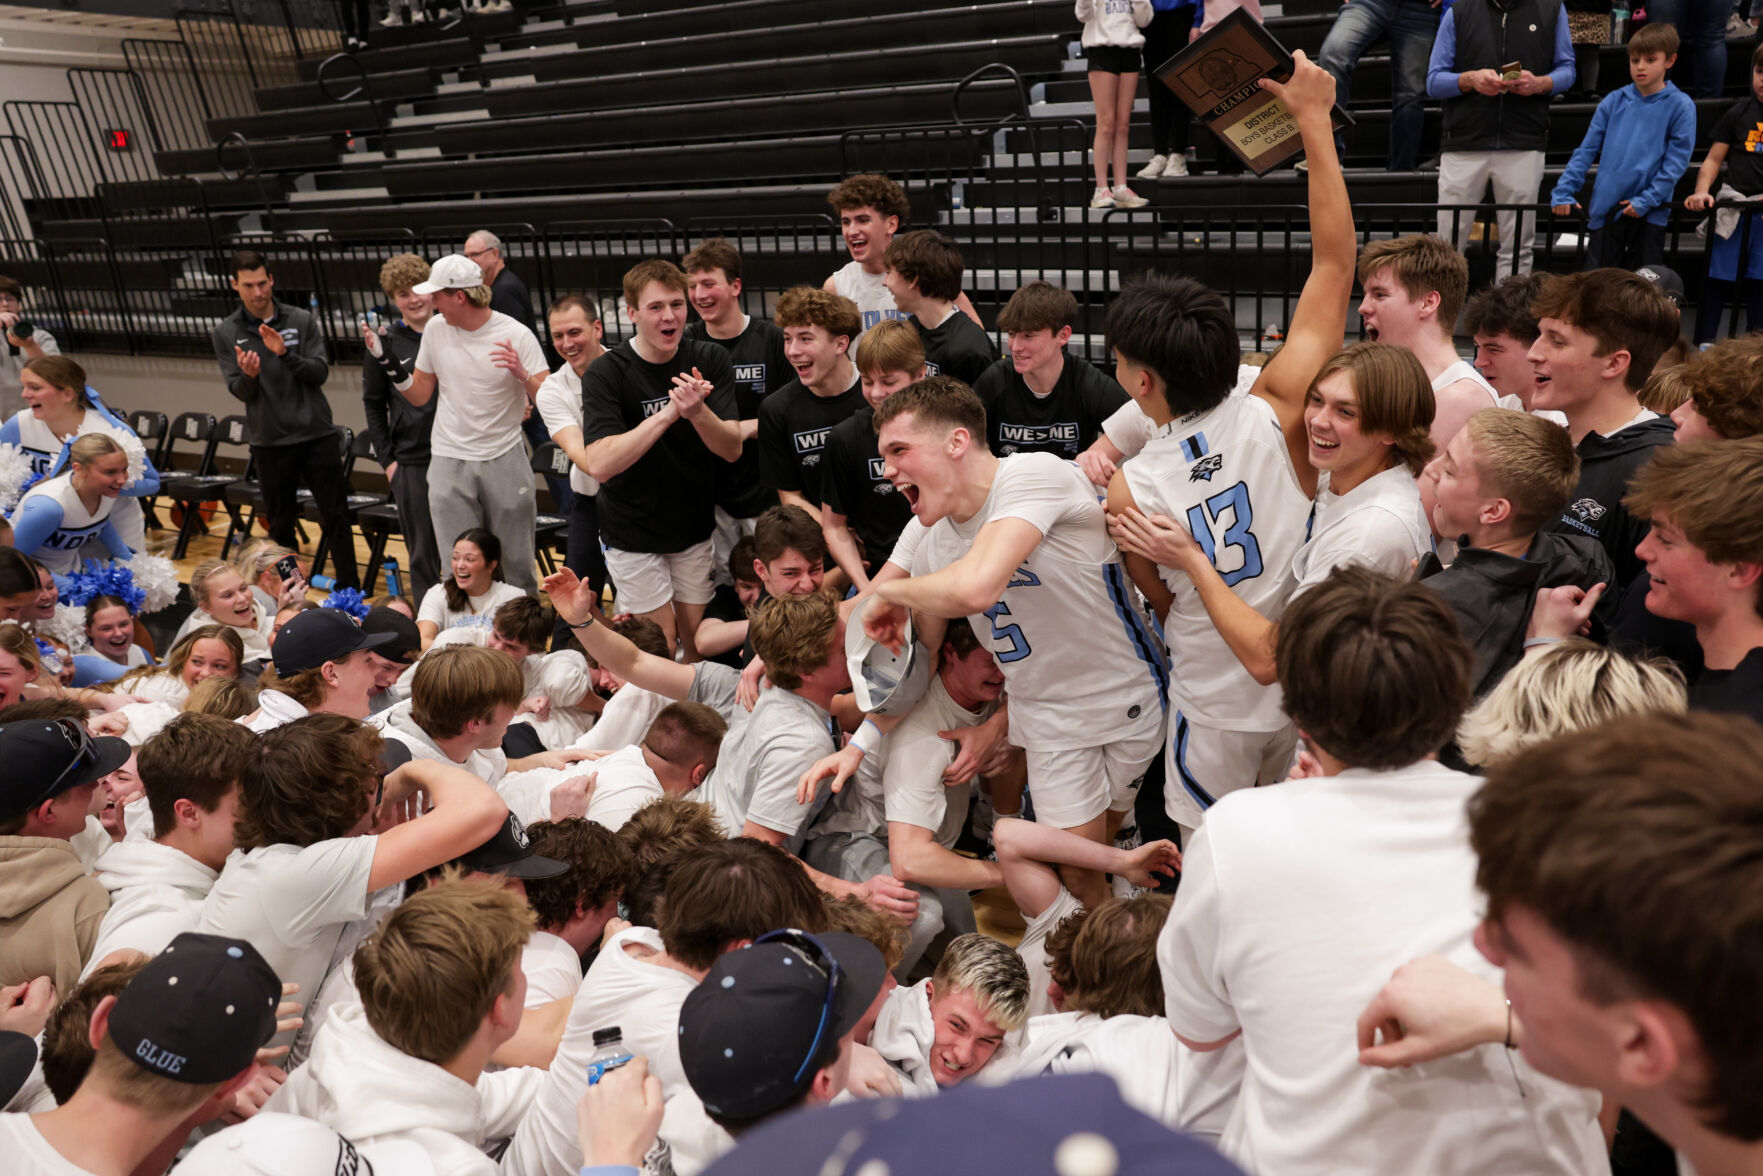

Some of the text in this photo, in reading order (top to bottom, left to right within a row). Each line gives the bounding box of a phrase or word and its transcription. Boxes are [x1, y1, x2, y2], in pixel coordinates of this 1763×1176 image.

[1244, 104, 1280, 129] DISTRICT
[1241, 130, 1261, 145] BOYS
[1264, 124, 1294, 144] CLASS B
[1186, 480, 1264, 588] 13
[136, 1038, 187, 1074] GLUE
